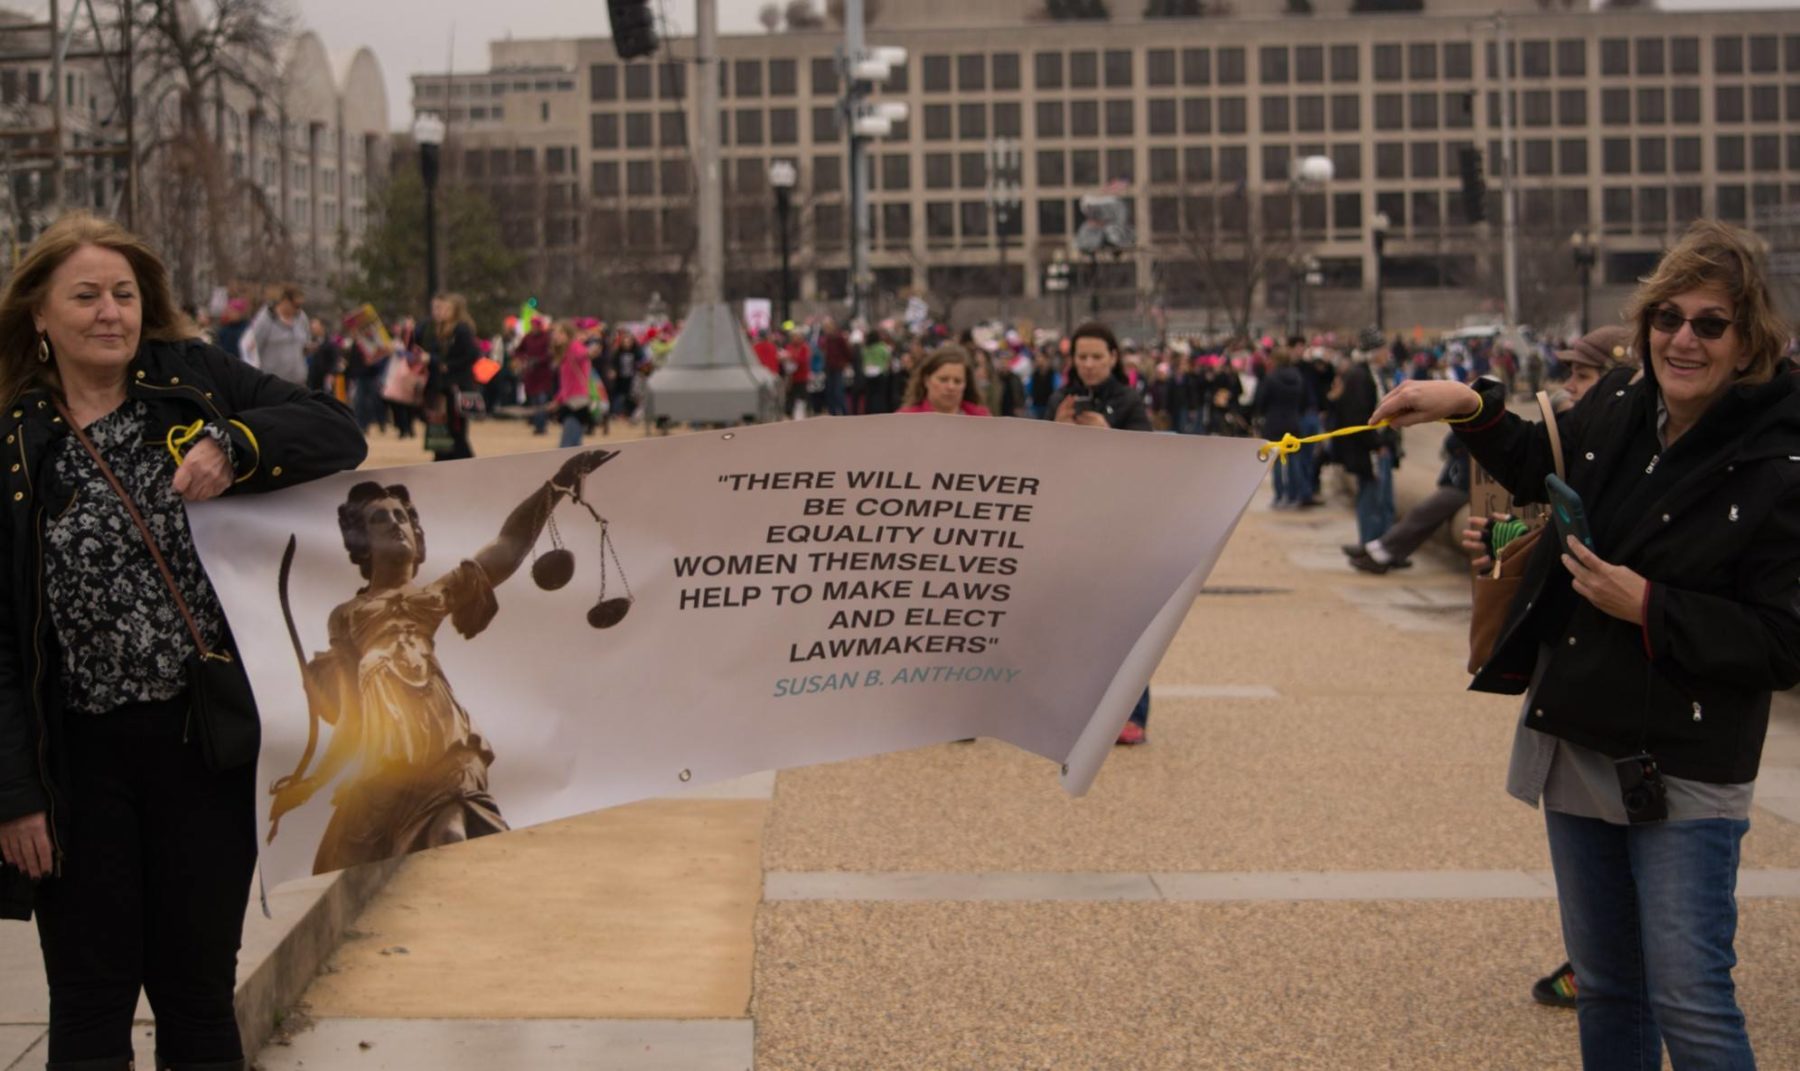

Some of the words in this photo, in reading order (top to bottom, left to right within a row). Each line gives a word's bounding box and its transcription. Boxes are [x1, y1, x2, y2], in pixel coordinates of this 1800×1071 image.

[717, 471, 837, 492] "THERE
[846, 470, 922, 490] WILL
[931, 472, 1040, 496] NEVER
[803, 498, 847, 516] BE
[855, 499, 1034, 523] COMPLETE
[765, 525, 925, 544] EQUALITY
[932, 527, 1025, 549] UNTIL
[673, 553, 798, 578] WOMEN
[808, 552, 1018, 575] THEMSELVES
[679, 586, 762, 610] HELP
[771, 584, 813, 606] TO
[822, 579, 913, 601] MAKE
[921, 581, 1011, 602] LAWS
[827, 609, 896, 629] AND
[904, 608, 1007, 628] ELECT
[789, 635, 999, 663] LAWMAKERS"
[772, 671, 859, 698] SUSAN
[863, 669, 884, 687] B.
[891, 666, 1023, 686] ANTHONY
